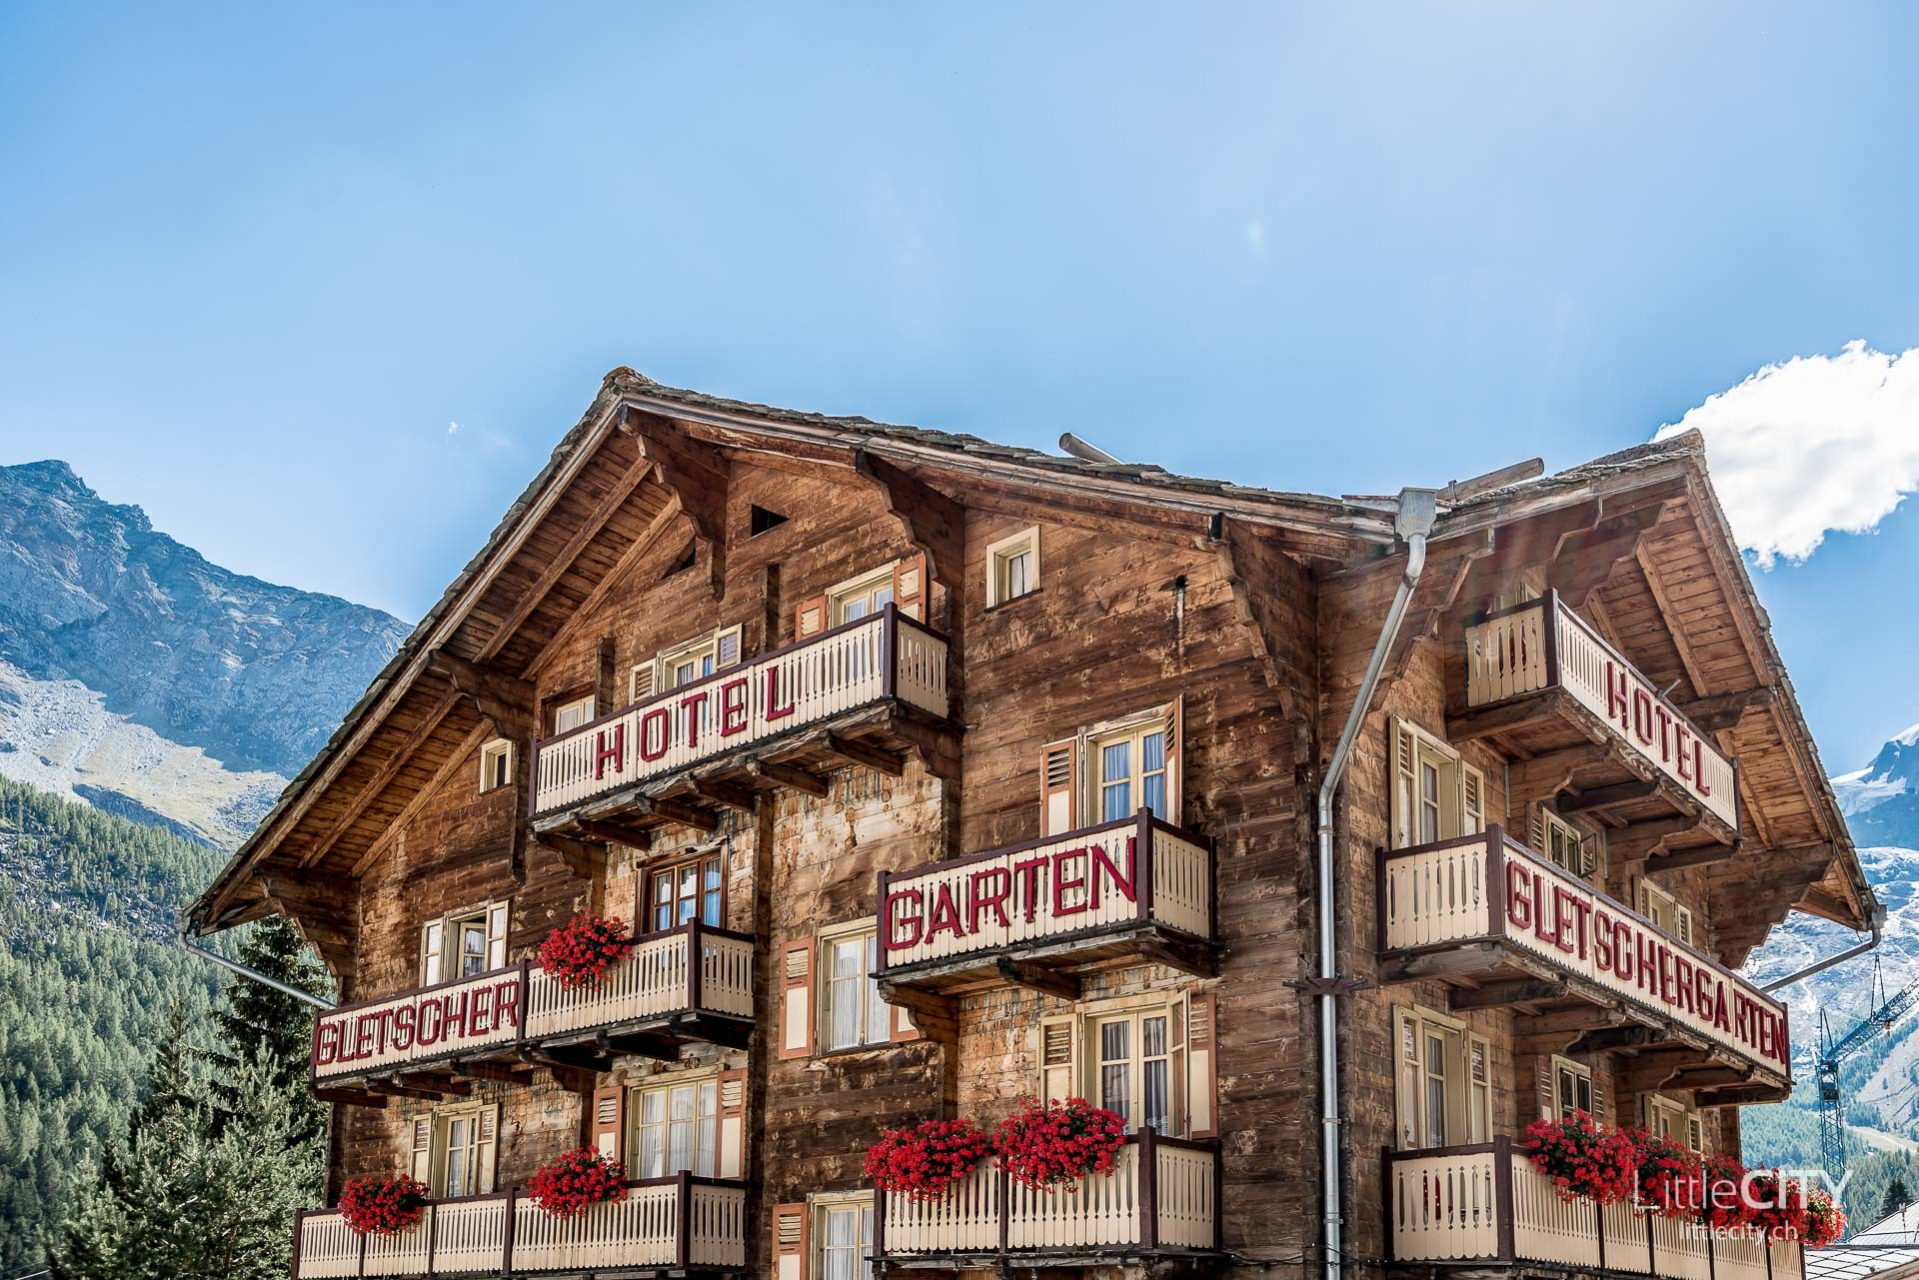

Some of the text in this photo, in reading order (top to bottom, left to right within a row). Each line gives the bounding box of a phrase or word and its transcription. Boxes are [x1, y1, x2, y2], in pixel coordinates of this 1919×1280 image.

[595, 666, 795, 780] HOTEL
[1607, 661, 1710, 796] HOTEL
[884, 836, 1138, 950] GARTEN
[1506, 860, 1787, 1064] GLETSCHERGARTEN
[313, 981, 519, 1065] GLETSCHER
